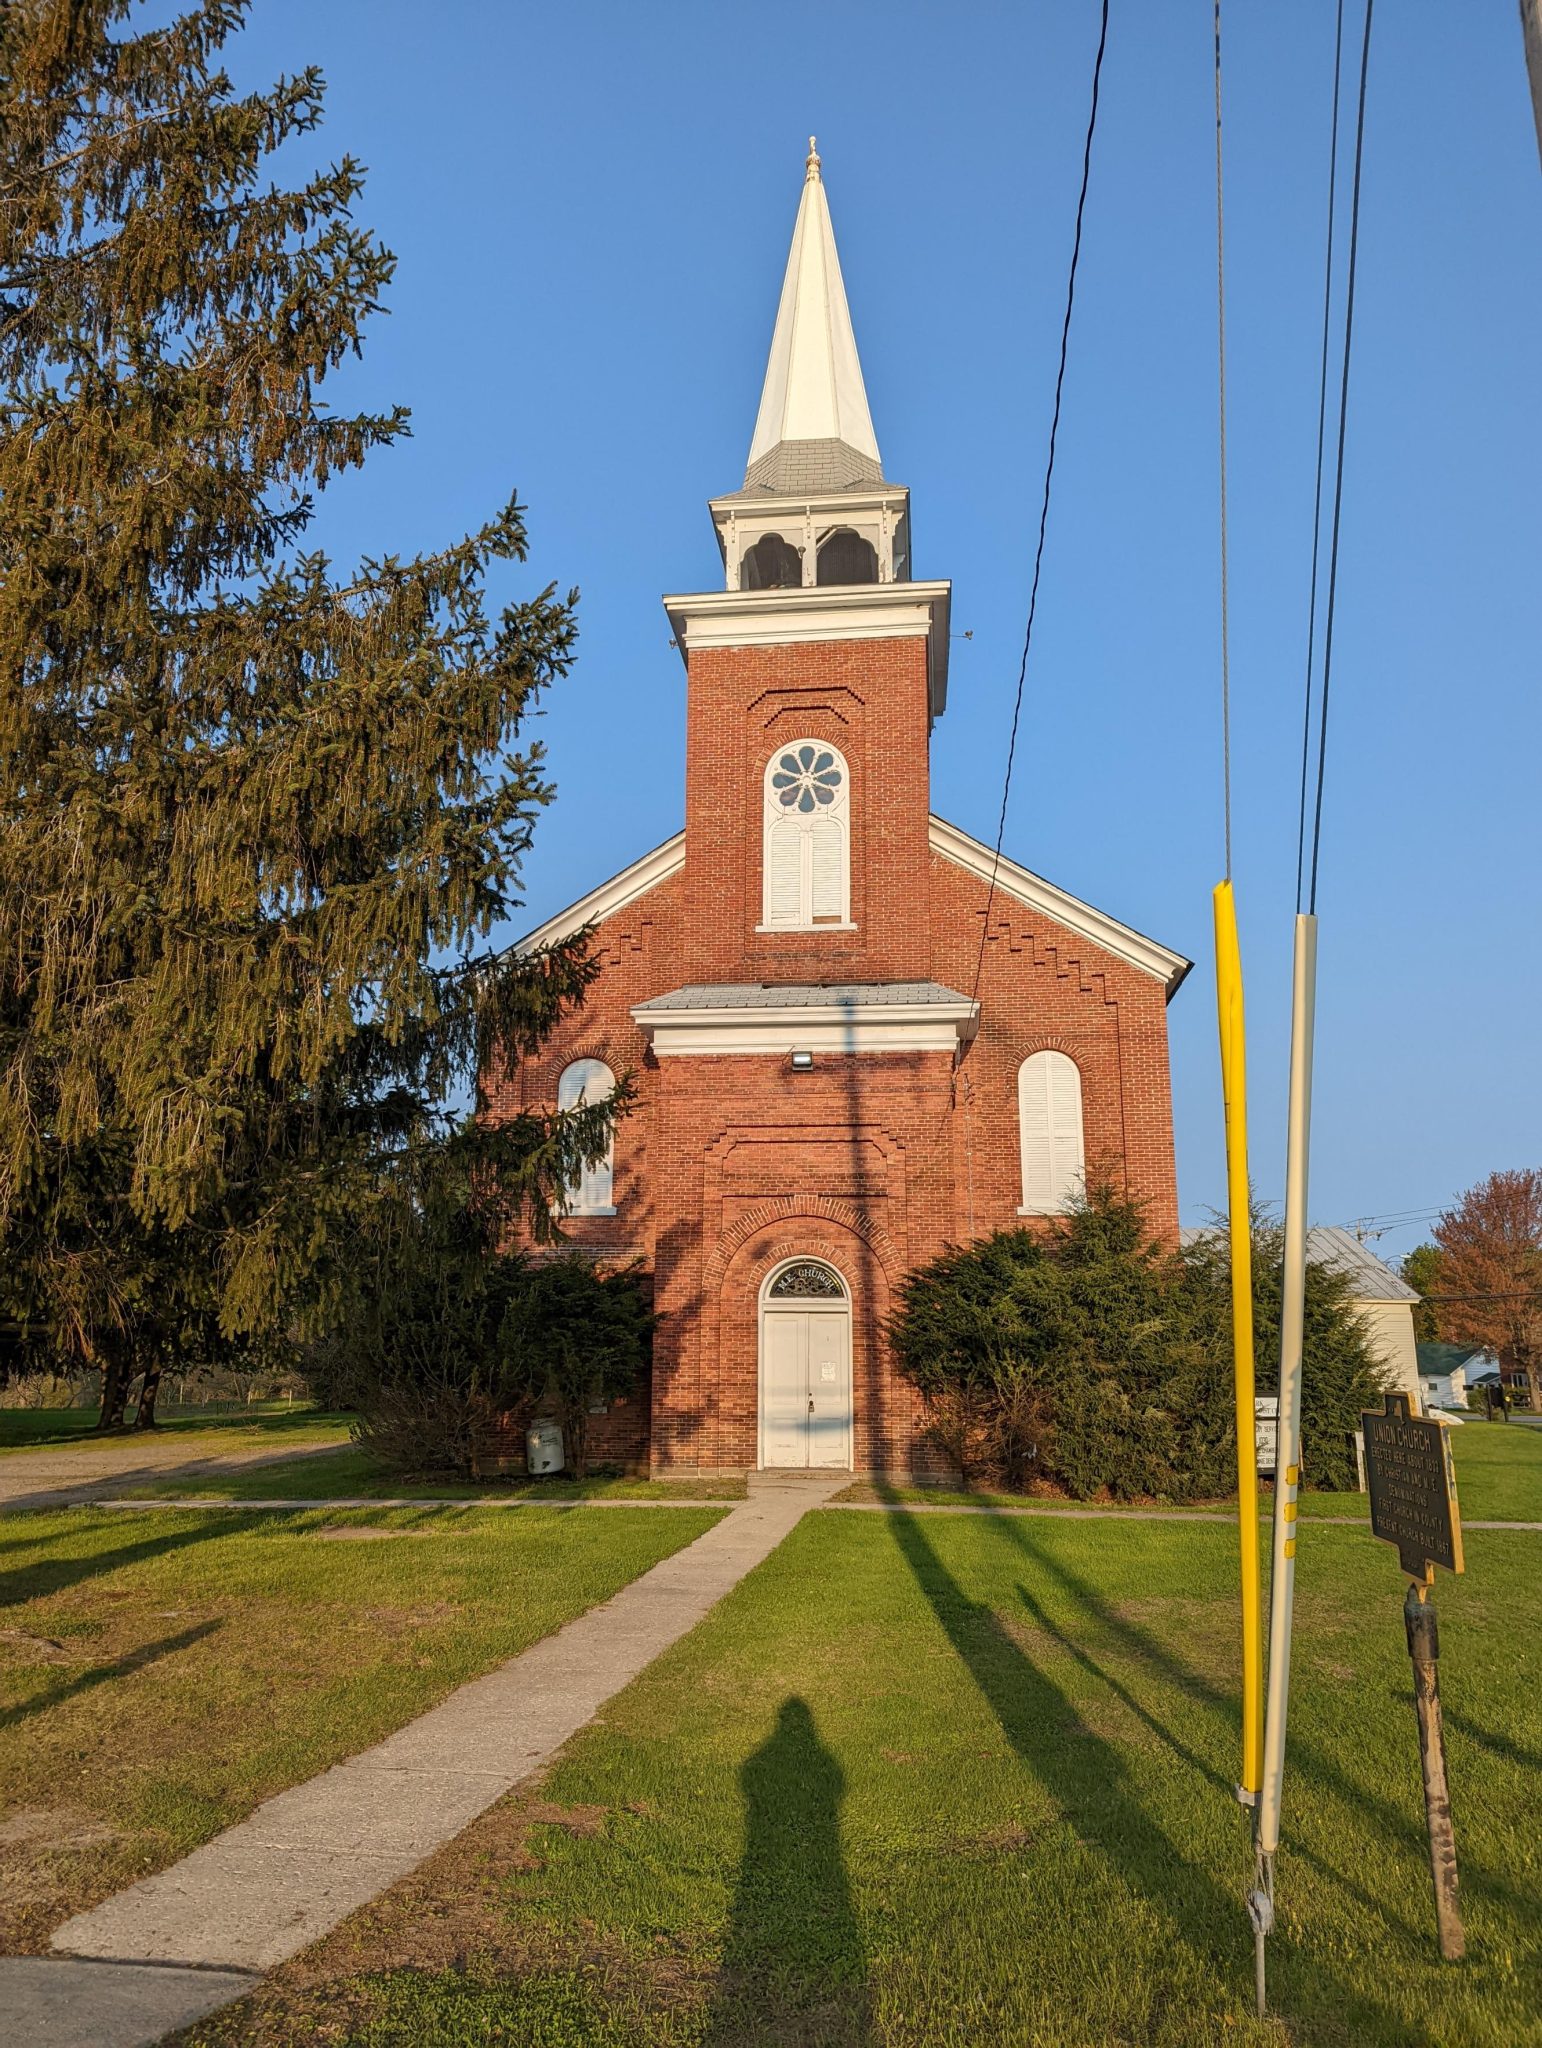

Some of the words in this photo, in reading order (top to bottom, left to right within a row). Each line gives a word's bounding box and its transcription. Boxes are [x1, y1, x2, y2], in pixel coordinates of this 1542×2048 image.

[798, 1269, 834, 1289] CHURCH
[1373, 1423, 1396, 1445] UNION
[1397, 1427, 1431, 1452] CHURCH
[1371, 1446, 1392, 1461] ERECTED
[1393, 1451, 1406, 1464] HERE
[1407, 1454, 1424, 1469] ABOUT
[1377, 1463, 1383, 1476] BY
[1384, 1466, 1410, 1483] CHRISTIAN
[1411, 1472, 1422, 1488] AND
[1388, 1483, 1427, 1507] DENOMINATIONS
[1378, 1497, 1392, 1513] FIRST
[1393, 1502, 1413, 1520] CHURCH
[1413, 1510, 1420, 1523] IN
[1421, 1513, 1443, 1532] COUNTY
[1376, 1515, 1397, 1534] PRESENT
[1399, 1523, 1419, 1543] CHURCH
[1420, 1532, 1435, 1549] BUILT
